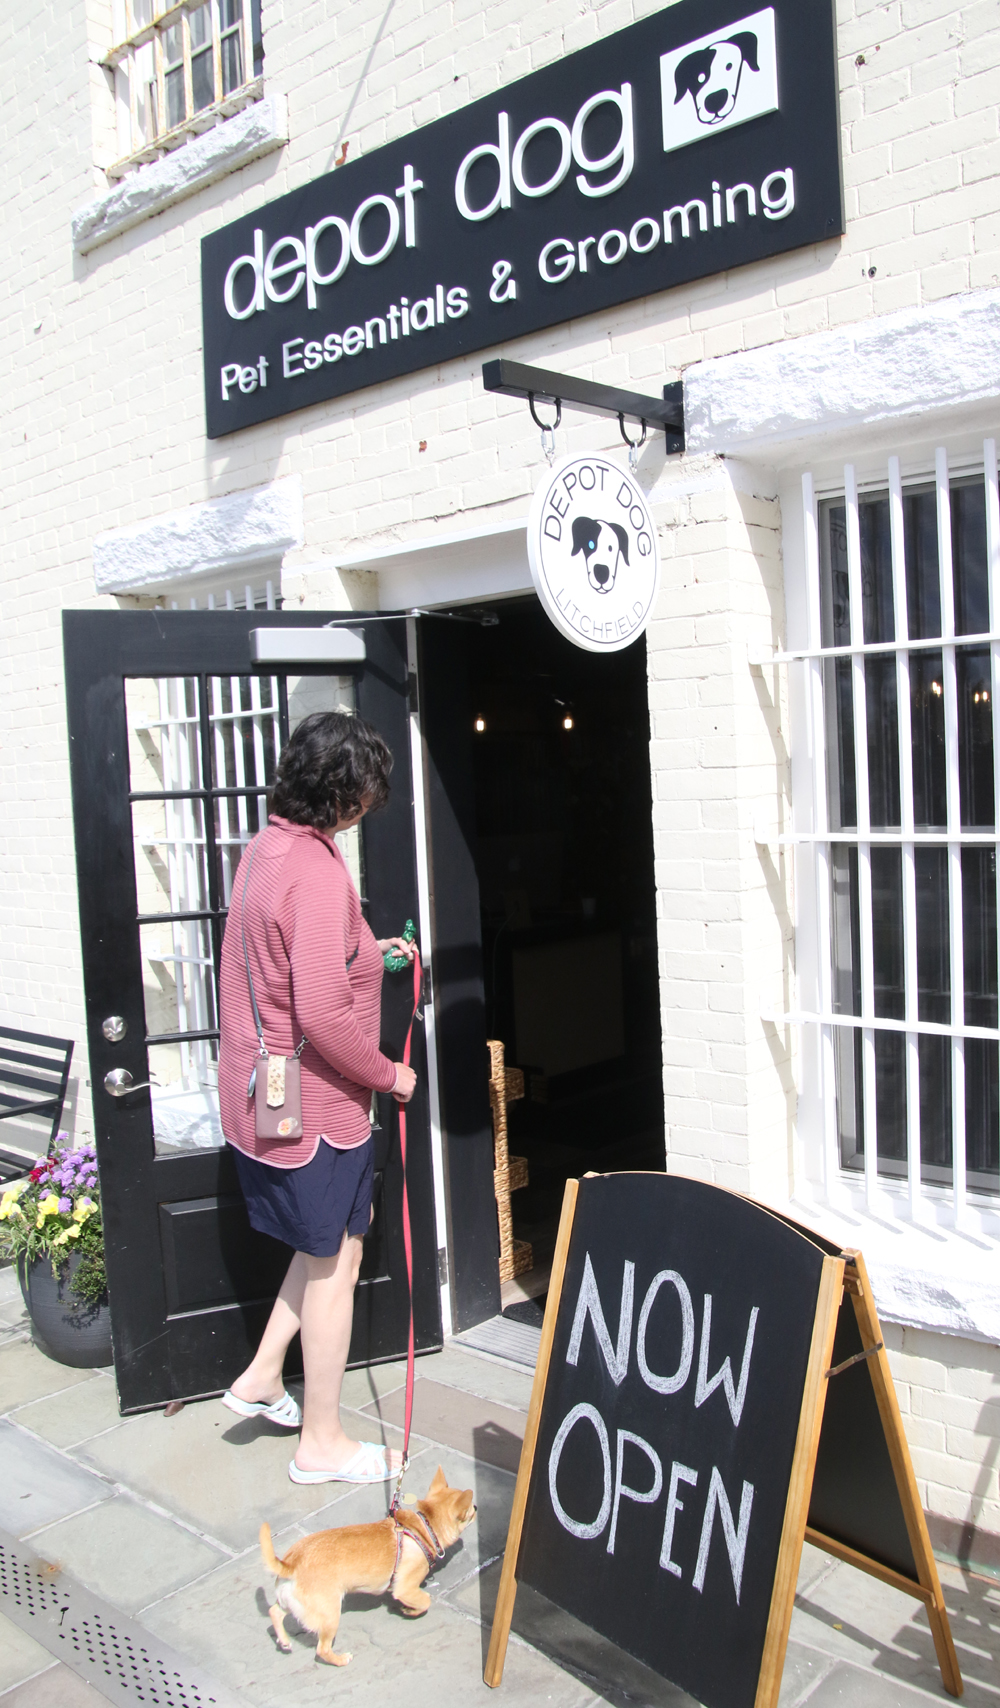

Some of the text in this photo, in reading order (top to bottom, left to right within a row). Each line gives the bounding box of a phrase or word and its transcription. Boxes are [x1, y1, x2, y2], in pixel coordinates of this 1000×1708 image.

[221, 168, 796, 400] Pet Essentials & Grooming
[223, 83, 634, 319] depot dog
[544, 465, 652, 556] DEPOT DOG
[555, 588, 645, 638] LITCHFIELD
[566, 1251, 760, 1427] NOW
[548, 1403, 755, 1606] OPEN
